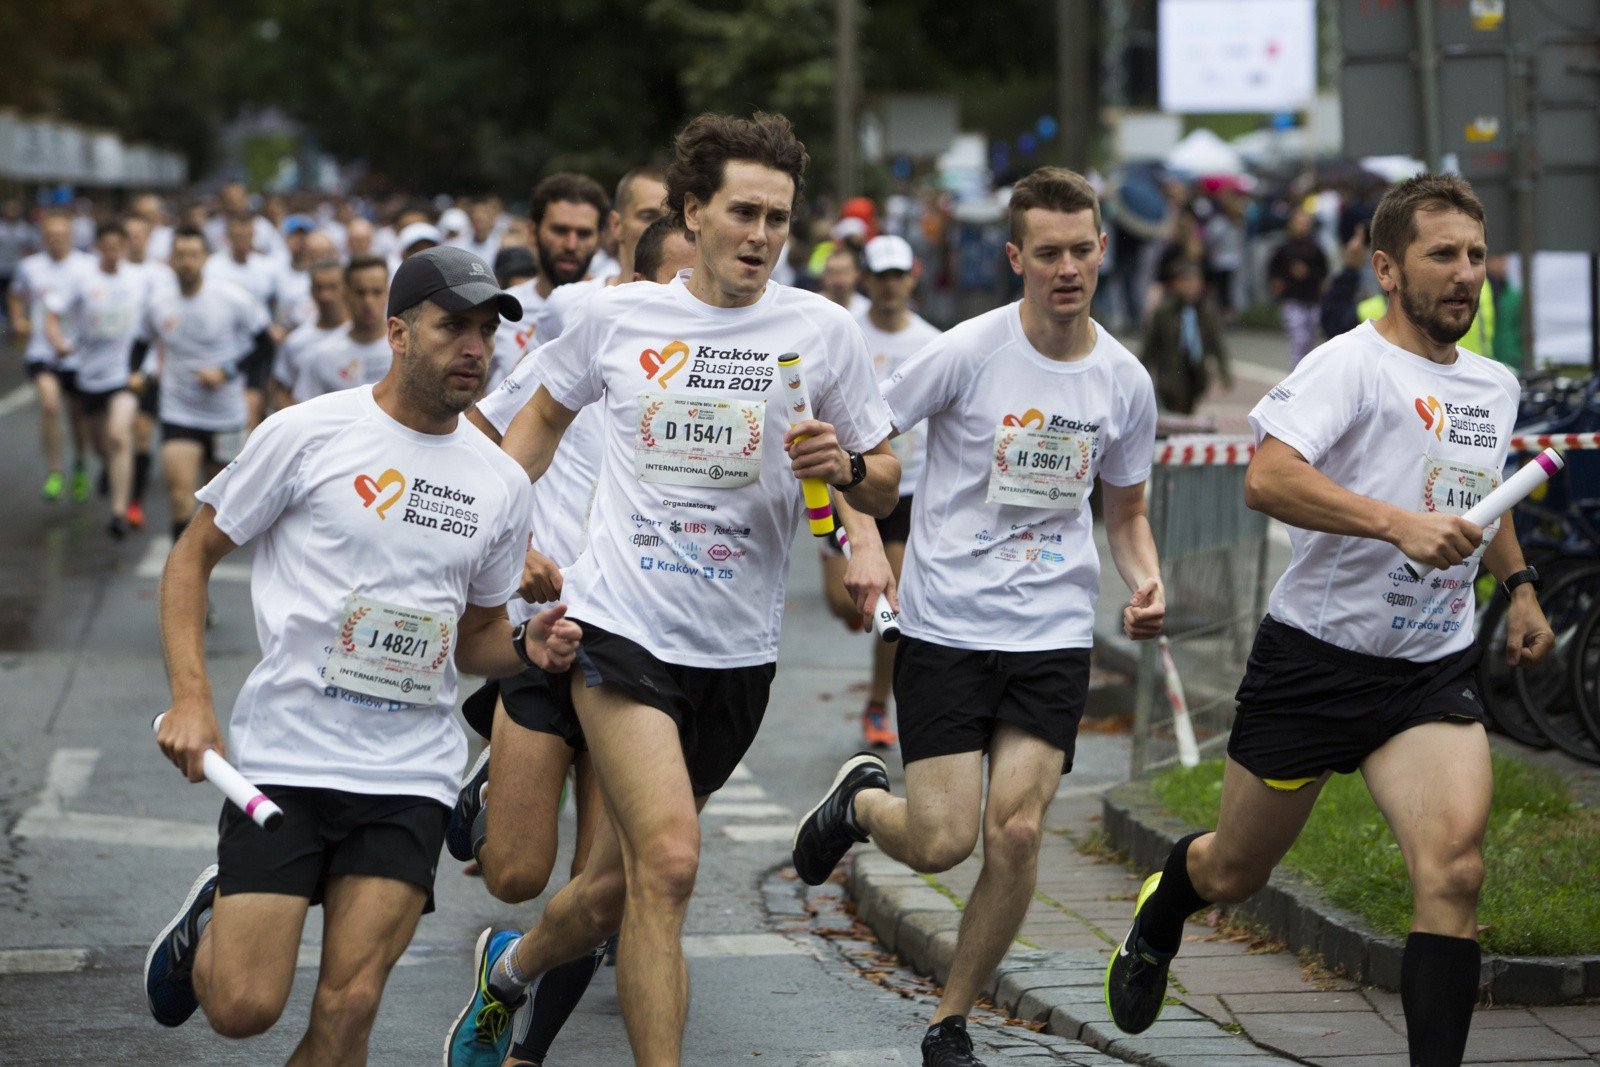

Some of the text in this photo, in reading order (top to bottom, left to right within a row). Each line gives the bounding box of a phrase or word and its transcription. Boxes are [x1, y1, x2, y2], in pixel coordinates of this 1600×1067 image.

[696, 345, 770, 361] Kraków
[691, 360, 774, 377] Business
[686, 374, 773, 392] Run 2017
[1445, 403, 1490, 419] Kraków
[665, 421, 733, 445] D 154/1
[1049, 414, 1100, 433] Kraków
[1448, 415, 1496, 434] Business
[1448, 429, 1498, 449] Run 2017
[1017, 450, 1028, 467] H
[1031, 452, 1071, 471] 396/1
[645, 463, 749, 478] INTERNATIONAL PAPER
[411, 478, 476, 506] Kraków
[998, 485, 1048, 497] INTERNATIONAL
[1446, 488, 1455, 507] A
[407, 493, 480, 524] Business
[402, 508, 478, 539] Run 2017
[684, 522, 707, 534] UBS
[633, 533, 660, 548] epam
[712, 548, 728, 556] KISS
[657, 560, 733, 579] Kraków ZIS
[1386, 592, 1414, 607] epam
[1406, 619, 1441, 631] Kraków
[368, 629, 429, 659] J 482/1
[340, 667, 401, 688] INTERNATIONAL
[413, 683, 432, 692] PAPER
